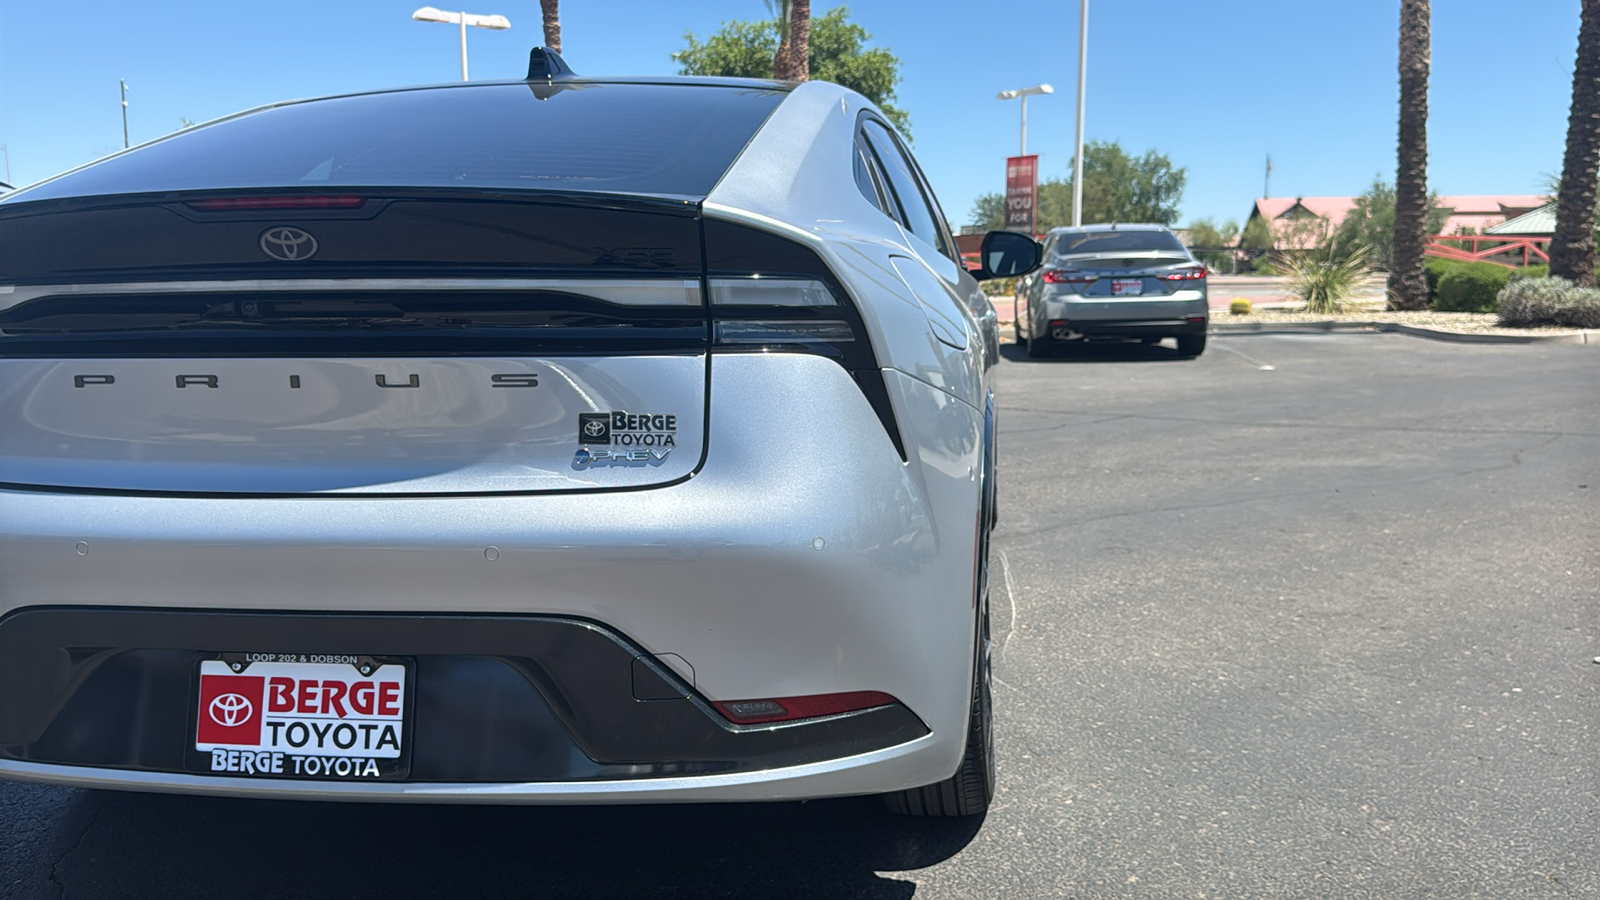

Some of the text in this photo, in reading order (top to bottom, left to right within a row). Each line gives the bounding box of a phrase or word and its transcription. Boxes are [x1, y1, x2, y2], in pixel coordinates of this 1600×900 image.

[1007, 197, 1032, 210] YOU
[593, 246, 675, 262] XSE
[74, 374, 539, 389] PRIUS
[611, 411, 677, 432] BERGE
[611, 433, 675, 446] TOYOTA
[592, 448, 672, 461] PHEV
[246, 653, 358, 664] LOOP 202 & DOBSON
[267, 676, 401, 719] BERGE
[266, 721, 400, 750] TOYOTA
[211, 749, 380, 777] BERGE TOYOTA
